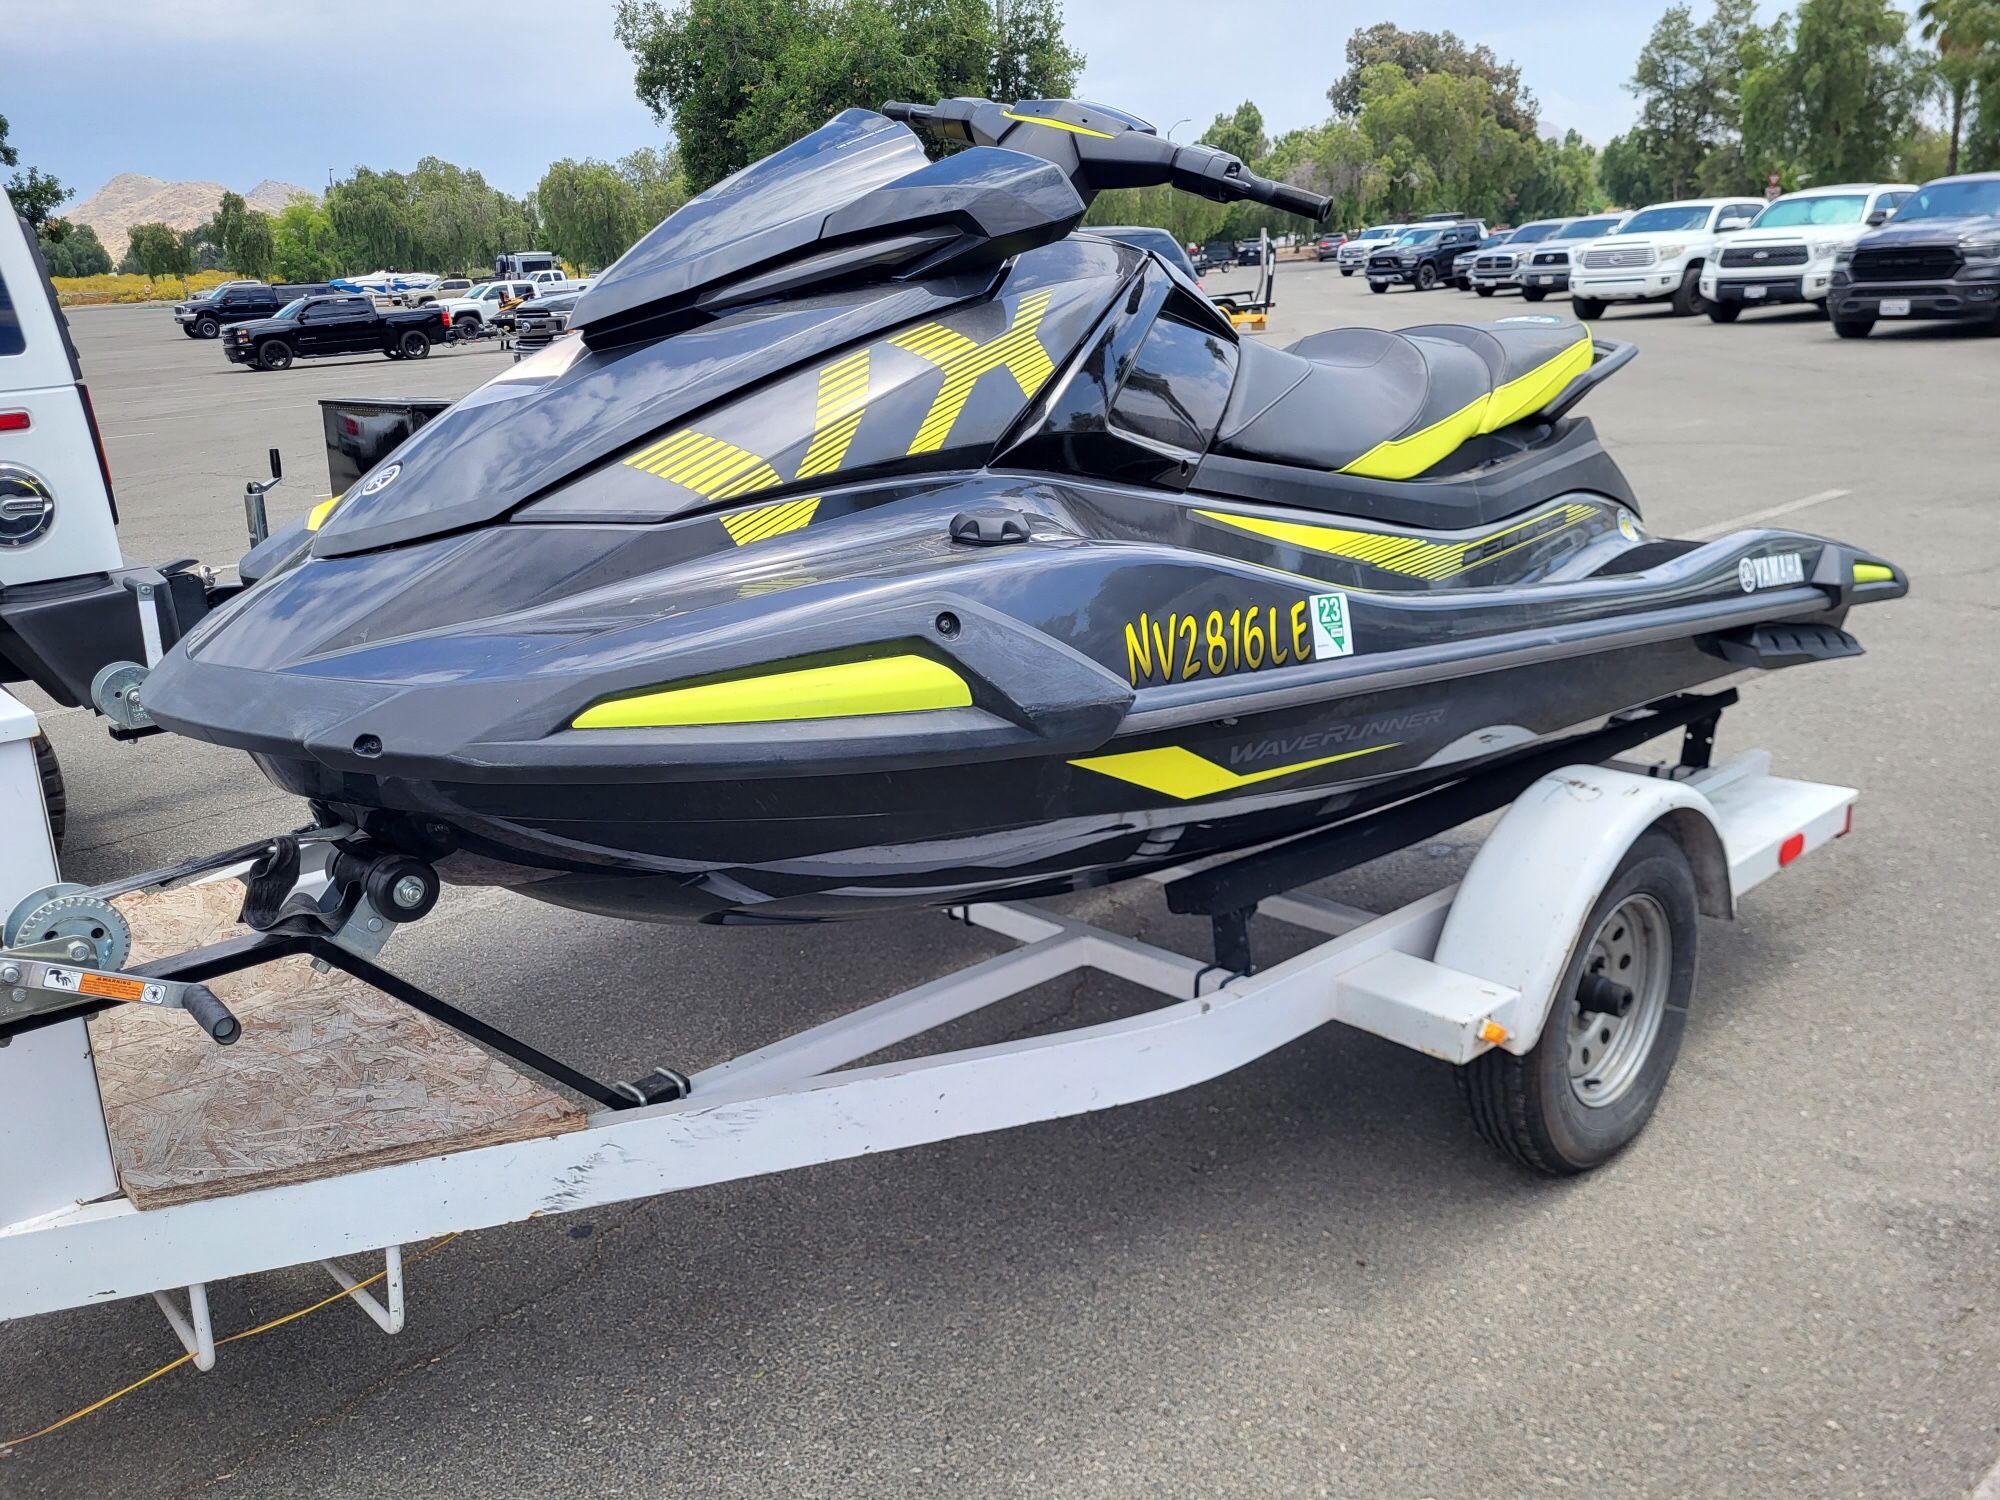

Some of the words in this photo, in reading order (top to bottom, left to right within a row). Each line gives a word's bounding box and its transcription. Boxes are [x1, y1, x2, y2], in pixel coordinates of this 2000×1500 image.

[1320, 597, 1341, 622] 23
[1124, 599, 1312, 689] NV2816LE
[1229, 708, 1446, 765] WAVERUNNER
[102, 977, 132, 986] WARNING
